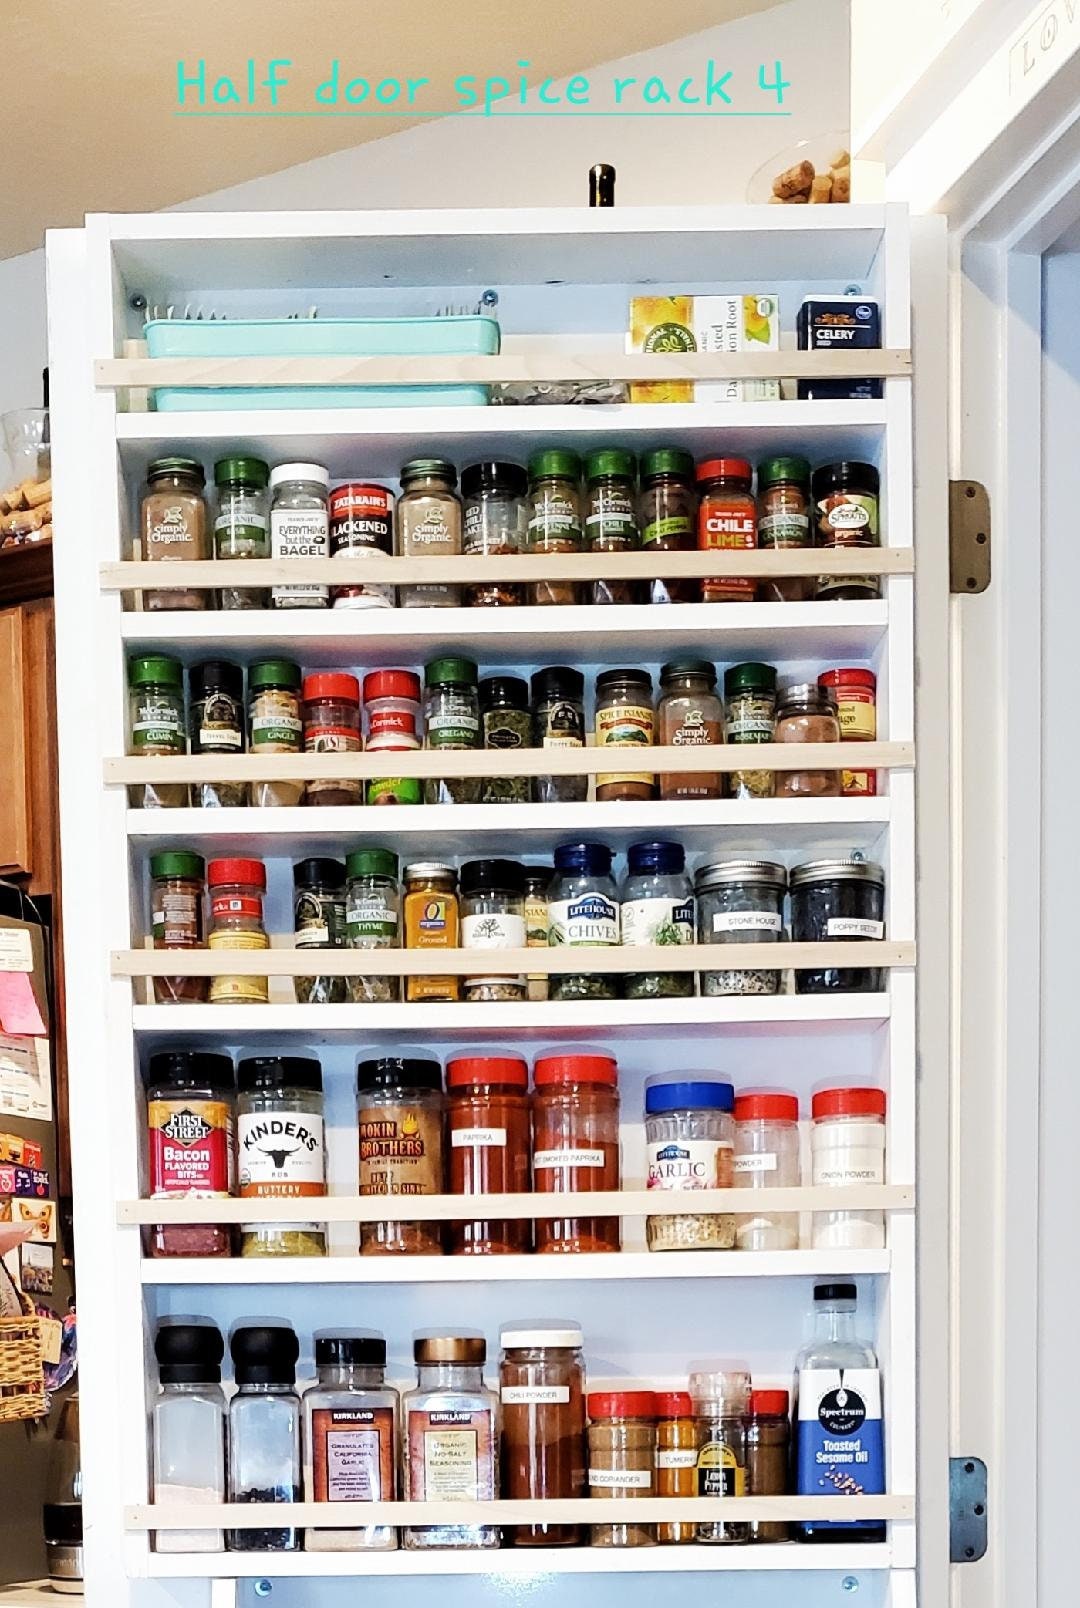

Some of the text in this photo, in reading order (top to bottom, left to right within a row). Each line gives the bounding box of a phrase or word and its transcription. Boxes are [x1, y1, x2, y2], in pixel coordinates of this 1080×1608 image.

[727, 301, 738, 330] Root
[816, 329, 856, 340] CELERY
[153, 522, 189, 536] Simply
[279, 525, 326, 535] EVERYTHING
[332, 520, 388, 537] LACKENED
[414, 522, 449, 536] Simply
[706, 519, 754, 533] CHILE
[151, 531, 194, 545] Organic
[285, 534, 312, 545] but the
[411, 532, 455, 545] Organic
[706, 533, 746, 548] LIME
[279, 545, 326, 556] BAGEL
[371, 716, 404, 728] Cormick
[674, 725, 710, 738] Simply
[672, 735, 713, 746] Organic
[350, 911, 392, 921] ORGANIC
[569, 904, 615, 917] LITEHOUSE
[357, 923, 383, 931] THYME
[728, 916, 777, 926] STONE HOUSE
[567, 924, 617, 940] CHIVES
[833, 923, 860, 932] POPPY
[418, 935, 448, 945] Ground
[170, 1113, 203, 1128] FIRST
[164, 1125, 209, 1139] STREET
[243, 1120, 317, 1152] KINDER'S
[360, 1122, 395, 1139] MOKIN
[462, 1133, 493, 1142] PAPRIKA
[163, 1146, 210, 1162] Bacon
[361, 1140, 422, 1158] BROTHERS
[543, 1154, 570, 1163] SMOKED
[570, 1154, 601, 1163] PAPRIKA
[164, 1162, 210, 1171] FLAVORED
[648, 1161, 707, 1179] GARLIC
[177, 1170, 198, 1179] BITS
[820, 1169, 876, 1179] ONION POWDER
[257, 1185, 301, 1195] BUTTERY
[509, 1390, 558, 1399] CHILI POWDER
[333, 1412, 374, 1420] KIRKLAND
[430, 1413, 471, 1421] KIRKLAND
[819, 1407, 865, 1419] Spectrum
[822, 1439, 861, 1452] Toasted
[815, 1450, 869, 1464] Sesame Oil
[599, 1475, 641, 1483] CORIANDER
